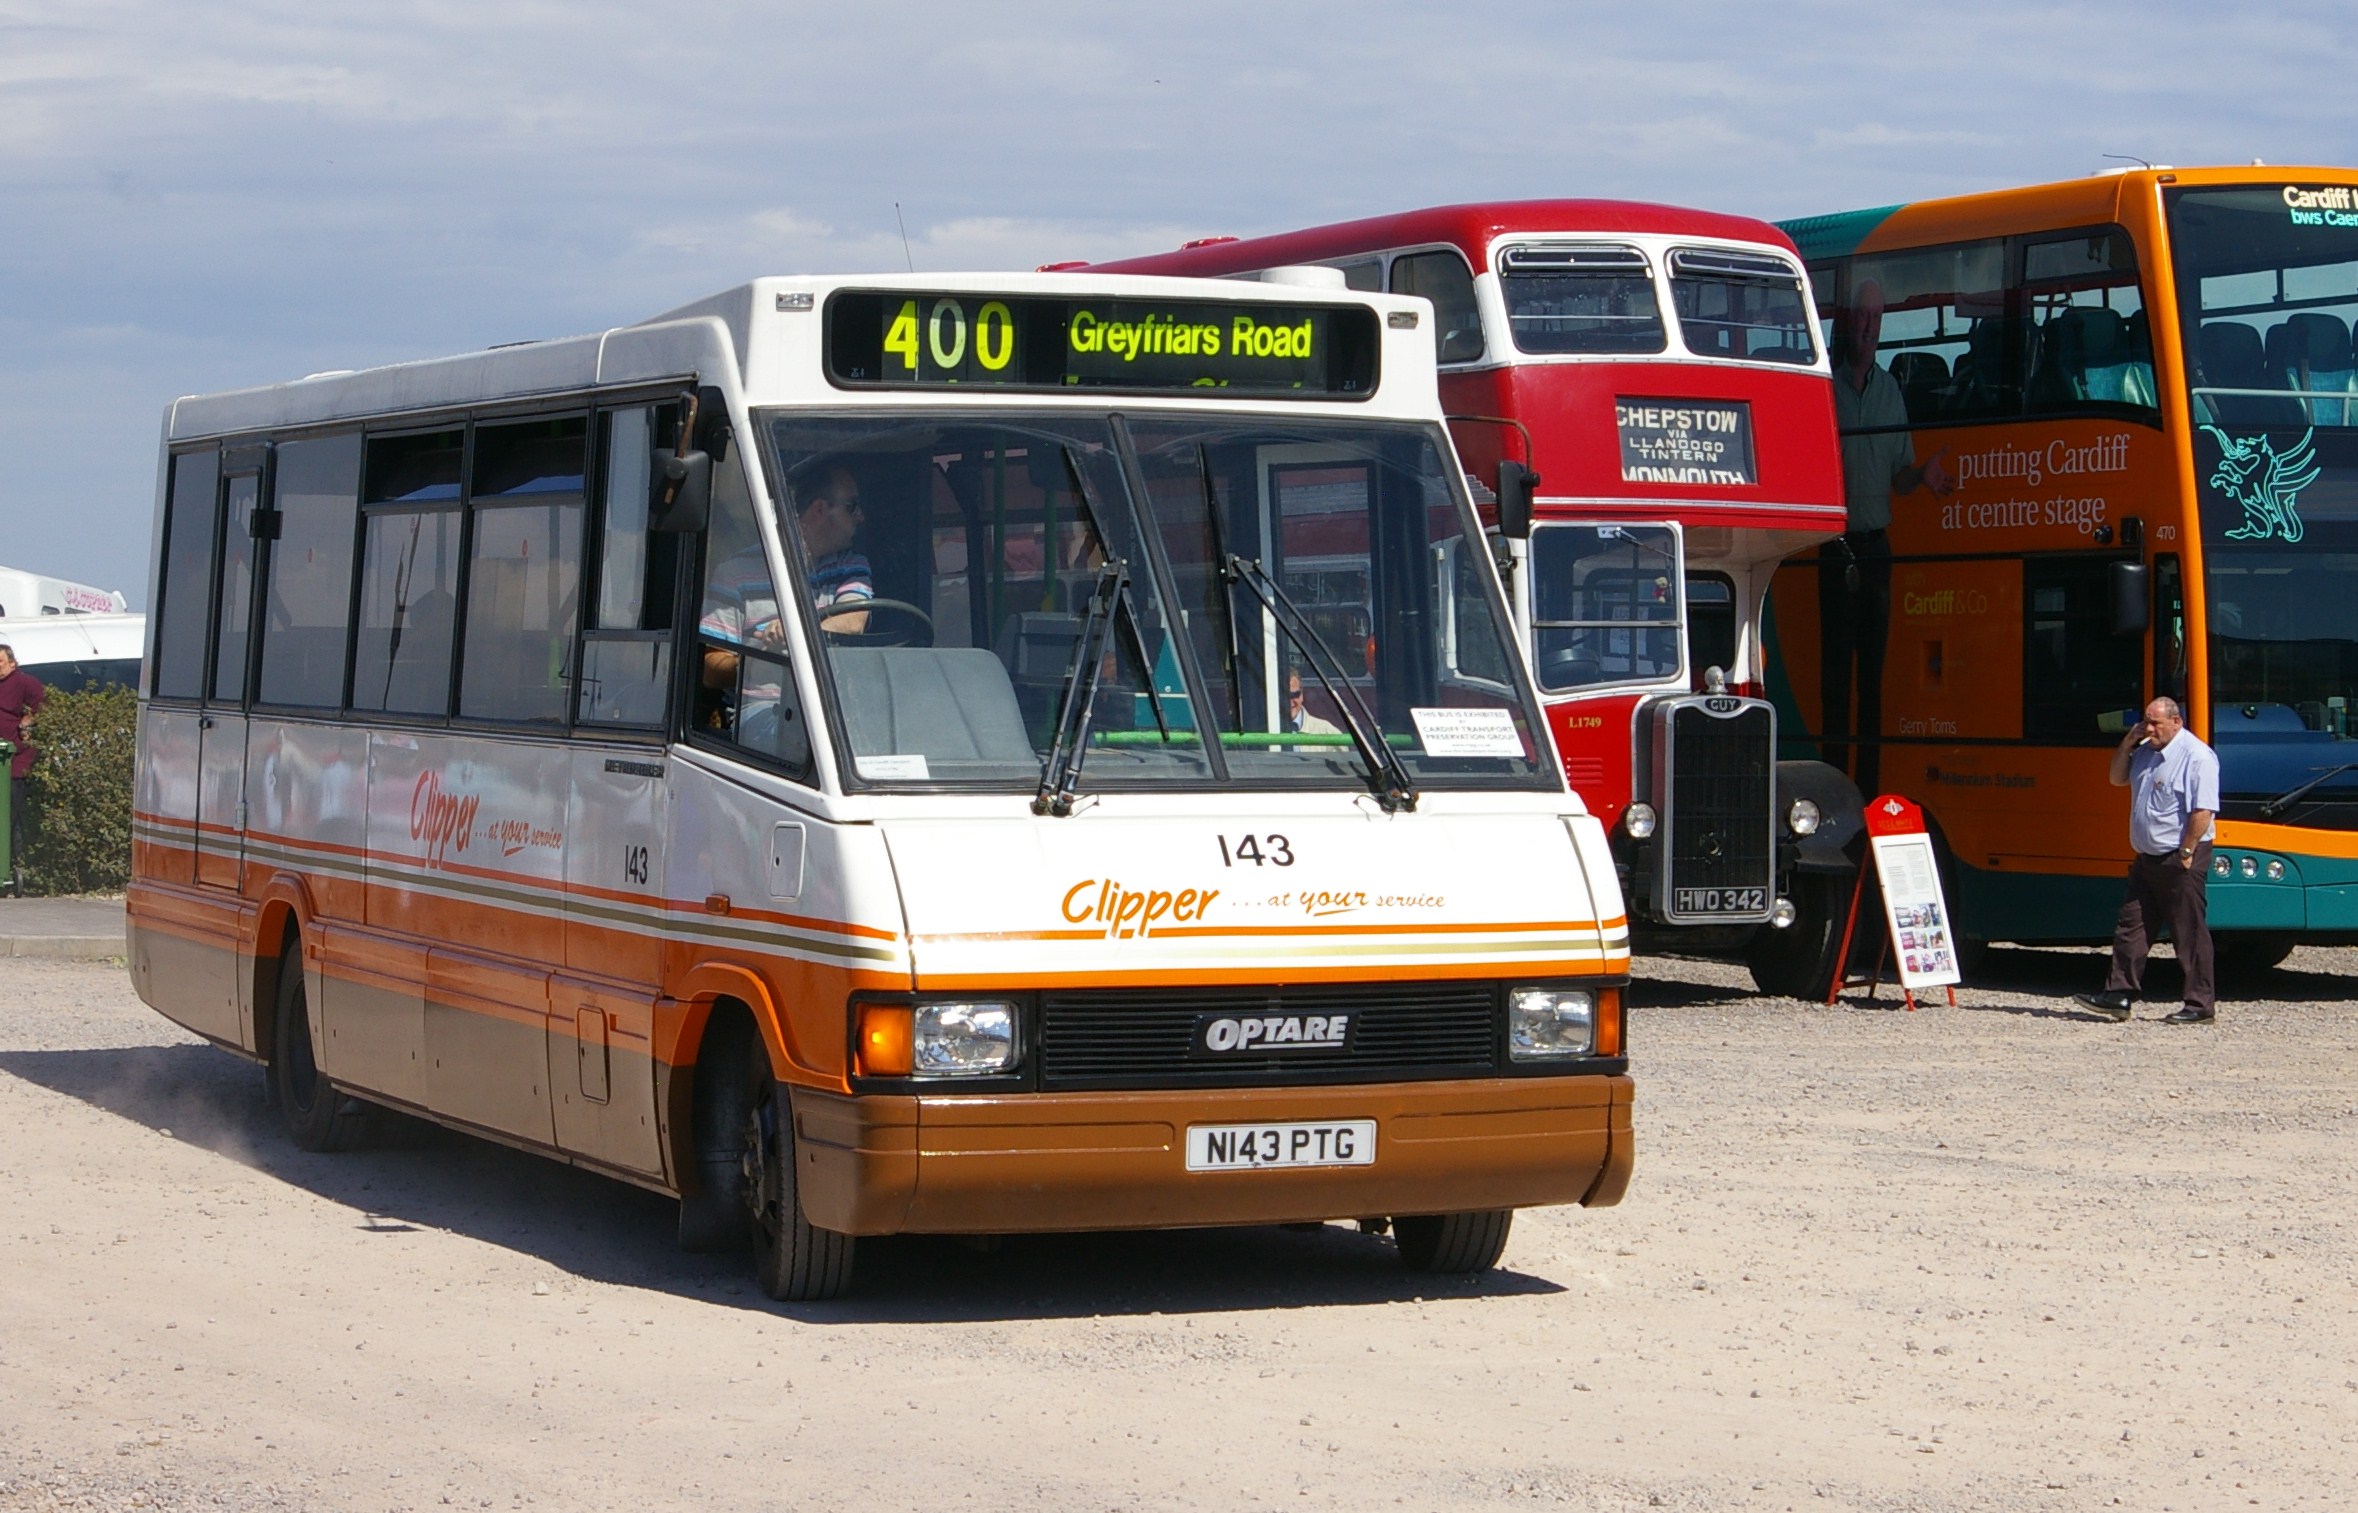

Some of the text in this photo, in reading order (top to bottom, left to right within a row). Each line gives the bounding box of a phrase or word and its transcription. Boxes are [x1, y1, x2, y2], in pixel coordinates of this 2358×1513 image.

[2283, 186, 2350, 209] Cardiff
[2290, 208, 2324, 225] bws
[883, 299, 1014, 371] 400
[1070, 310, 1313, 361] Greyfriars Road
[1615, 405, 1738, 433] CHEPSTOW
[1629, 437, 1724, 453] LLANDOGO
[1667, 429, 1688, 439] VIA
[1639, 449, 1718, 463] TINTERN
[1957, 433, 2131, 490] putting Cardiff
[1941, 495, 2106, 535] at centre stage
[2156, 525, 2176, 541] 470
[1710, 700, 1737, 711] GUY
[1568, 717, 1602, 729] L1749
[1899, 717, 1957, 736] Gerry Toms
[410, 770, 480, 869] Clipper
[500, 819, 530, 853] your
[530, 828, 563, 851] service
[624, 844, 649, 885] 143
[1217, 834, 1296, 867] 143
[1061, 878, 1220, 938] Clipper
[1300, 889, 1369, 913] your
[1375, 892, 1446, 908] service
[1679, 889, 1764, 911] HWO 342
[1205, 1015, 1349, 1051] OPTARE
[1207, 1128, 1355, 1164] N143 PTG
